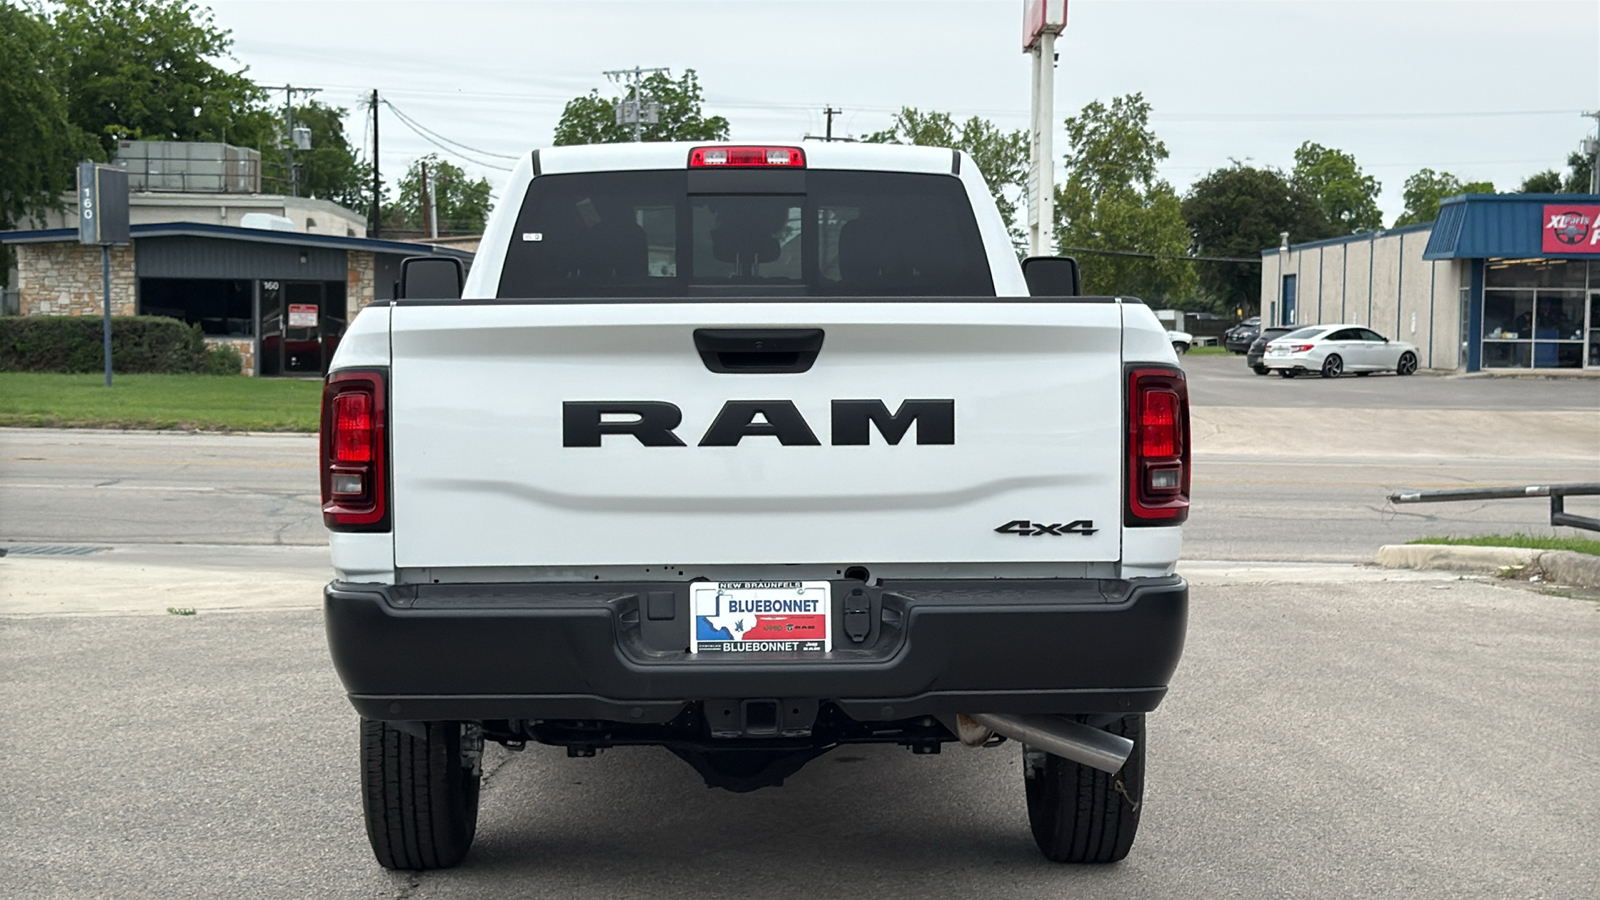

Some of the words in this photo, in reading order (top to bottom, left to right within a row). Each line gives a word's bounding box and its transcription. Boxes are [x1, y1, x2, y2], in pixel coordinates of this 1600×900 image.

[84, 188, 93, 219] 160
[263, 281, 279, 290] 160
[563, 399, 955, 447] RAM
[993, 520, 1099, 536] 4x4
[729, 600, 819, 613] BLUEBONNET
[723, 642, 799, 652] BLUEBONNET
